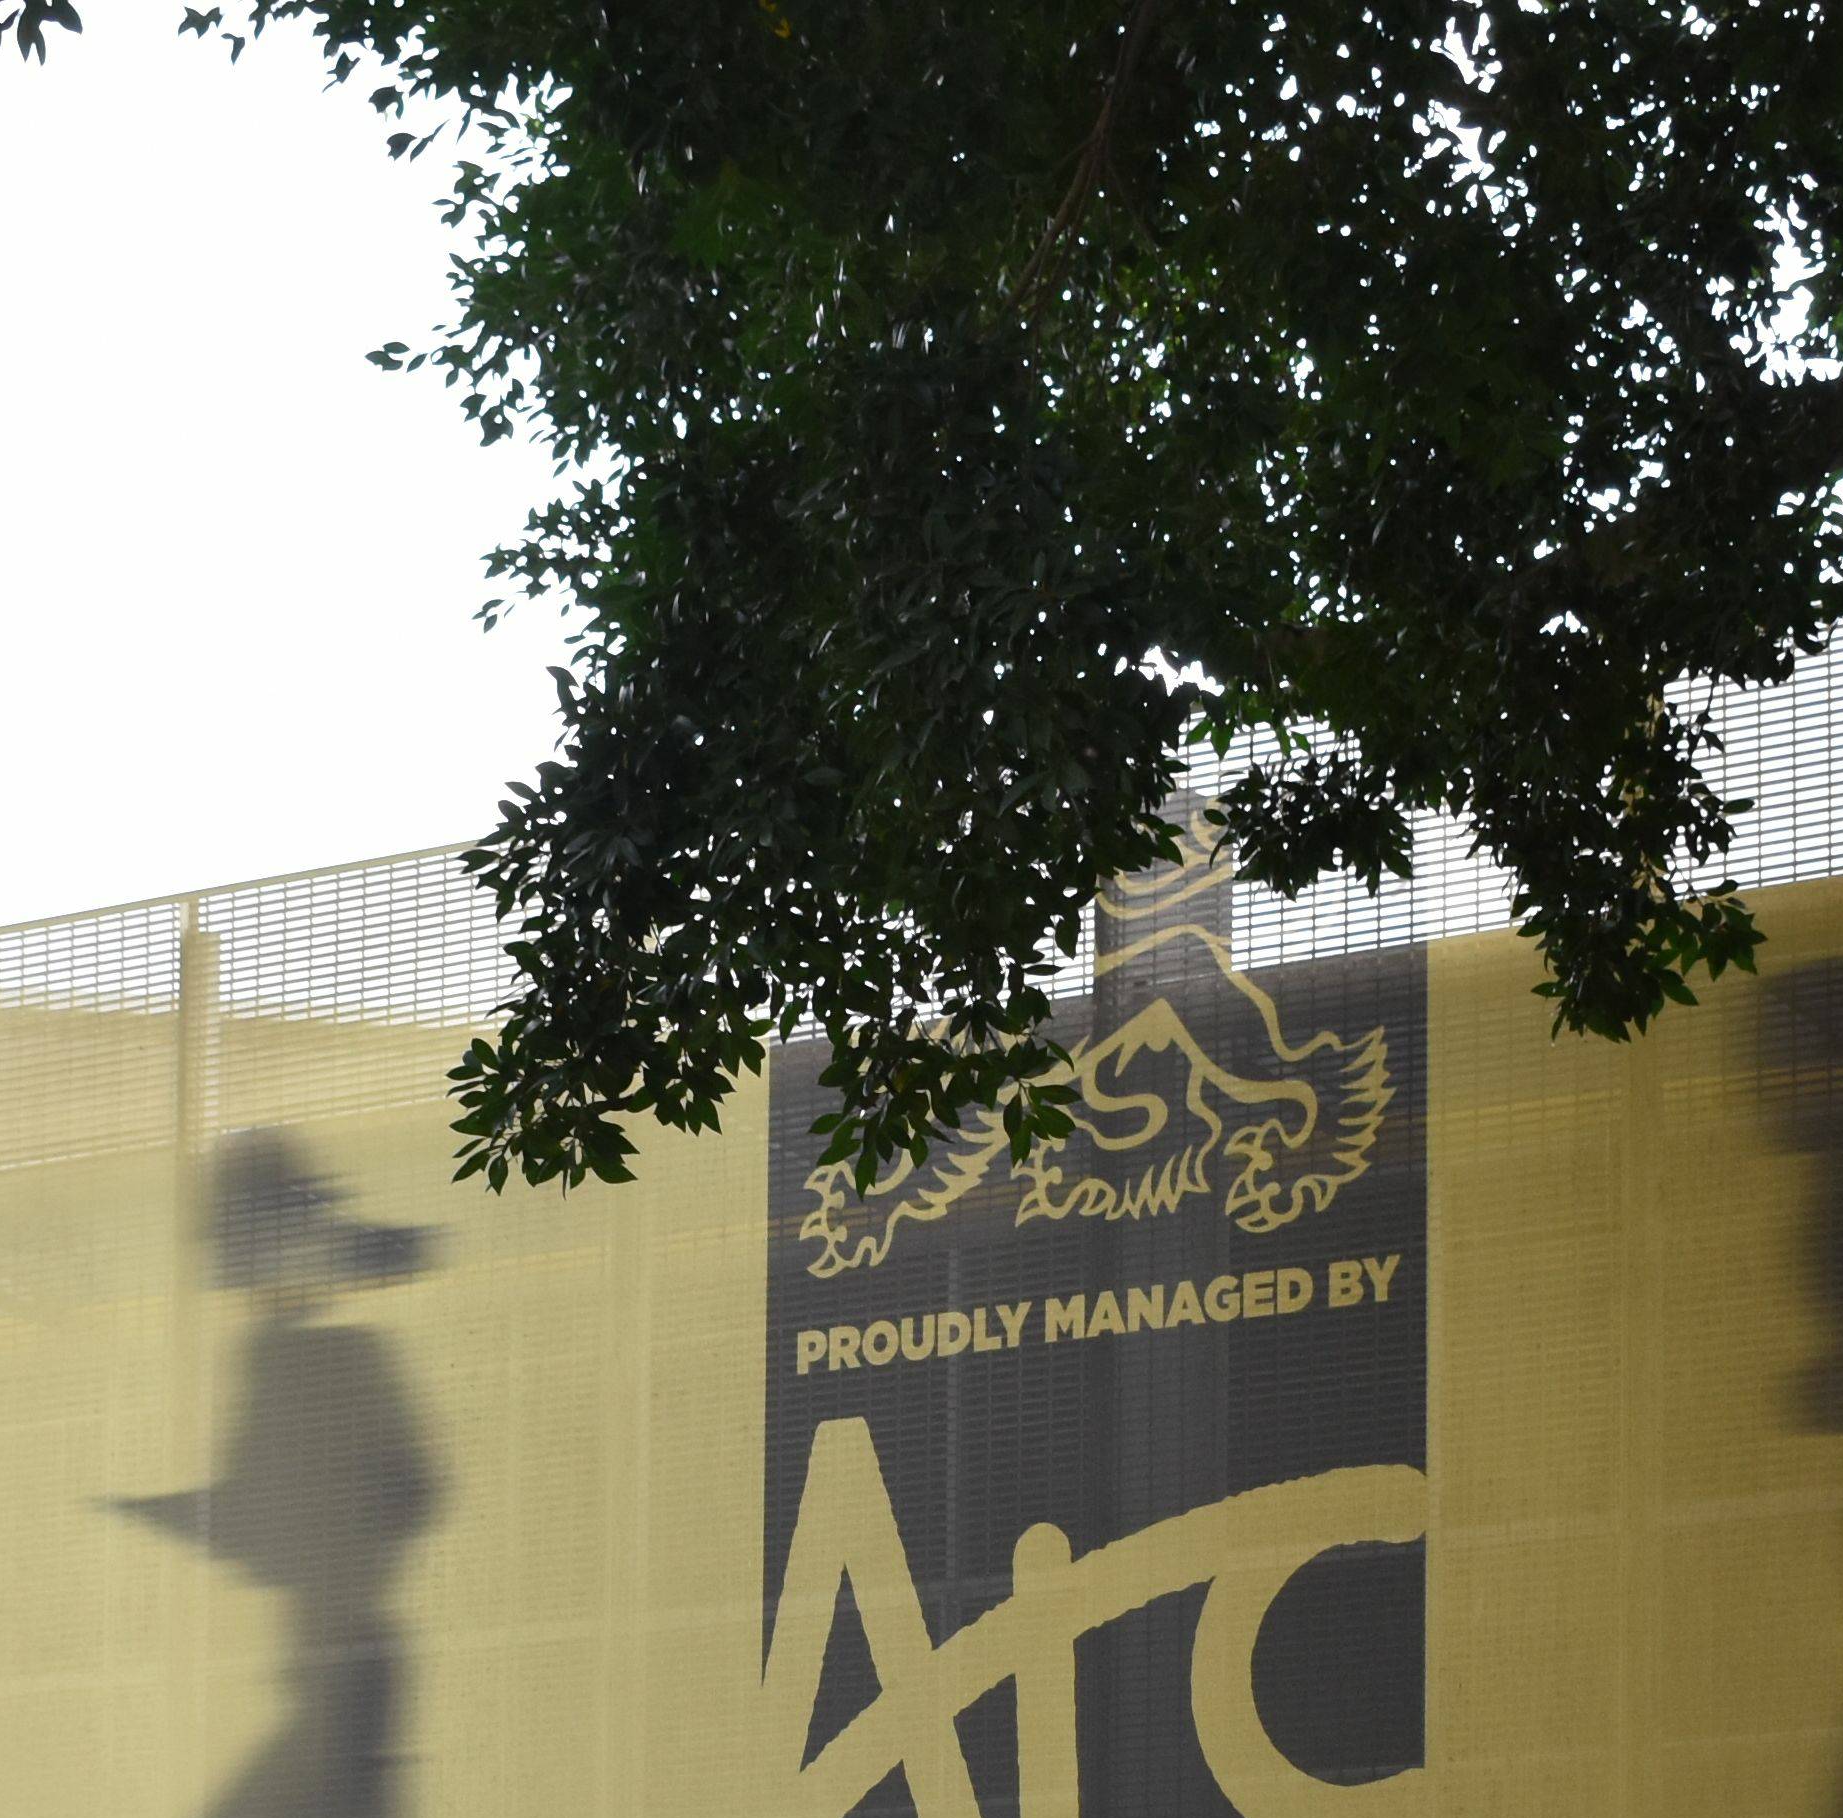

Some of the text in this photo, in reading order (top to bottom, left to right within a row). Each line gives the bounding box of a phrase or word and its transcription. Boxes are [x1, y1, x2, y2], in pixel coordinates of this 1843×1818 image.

[797, 1254, 1400, 1375] PROUDLY MANAGED BY
